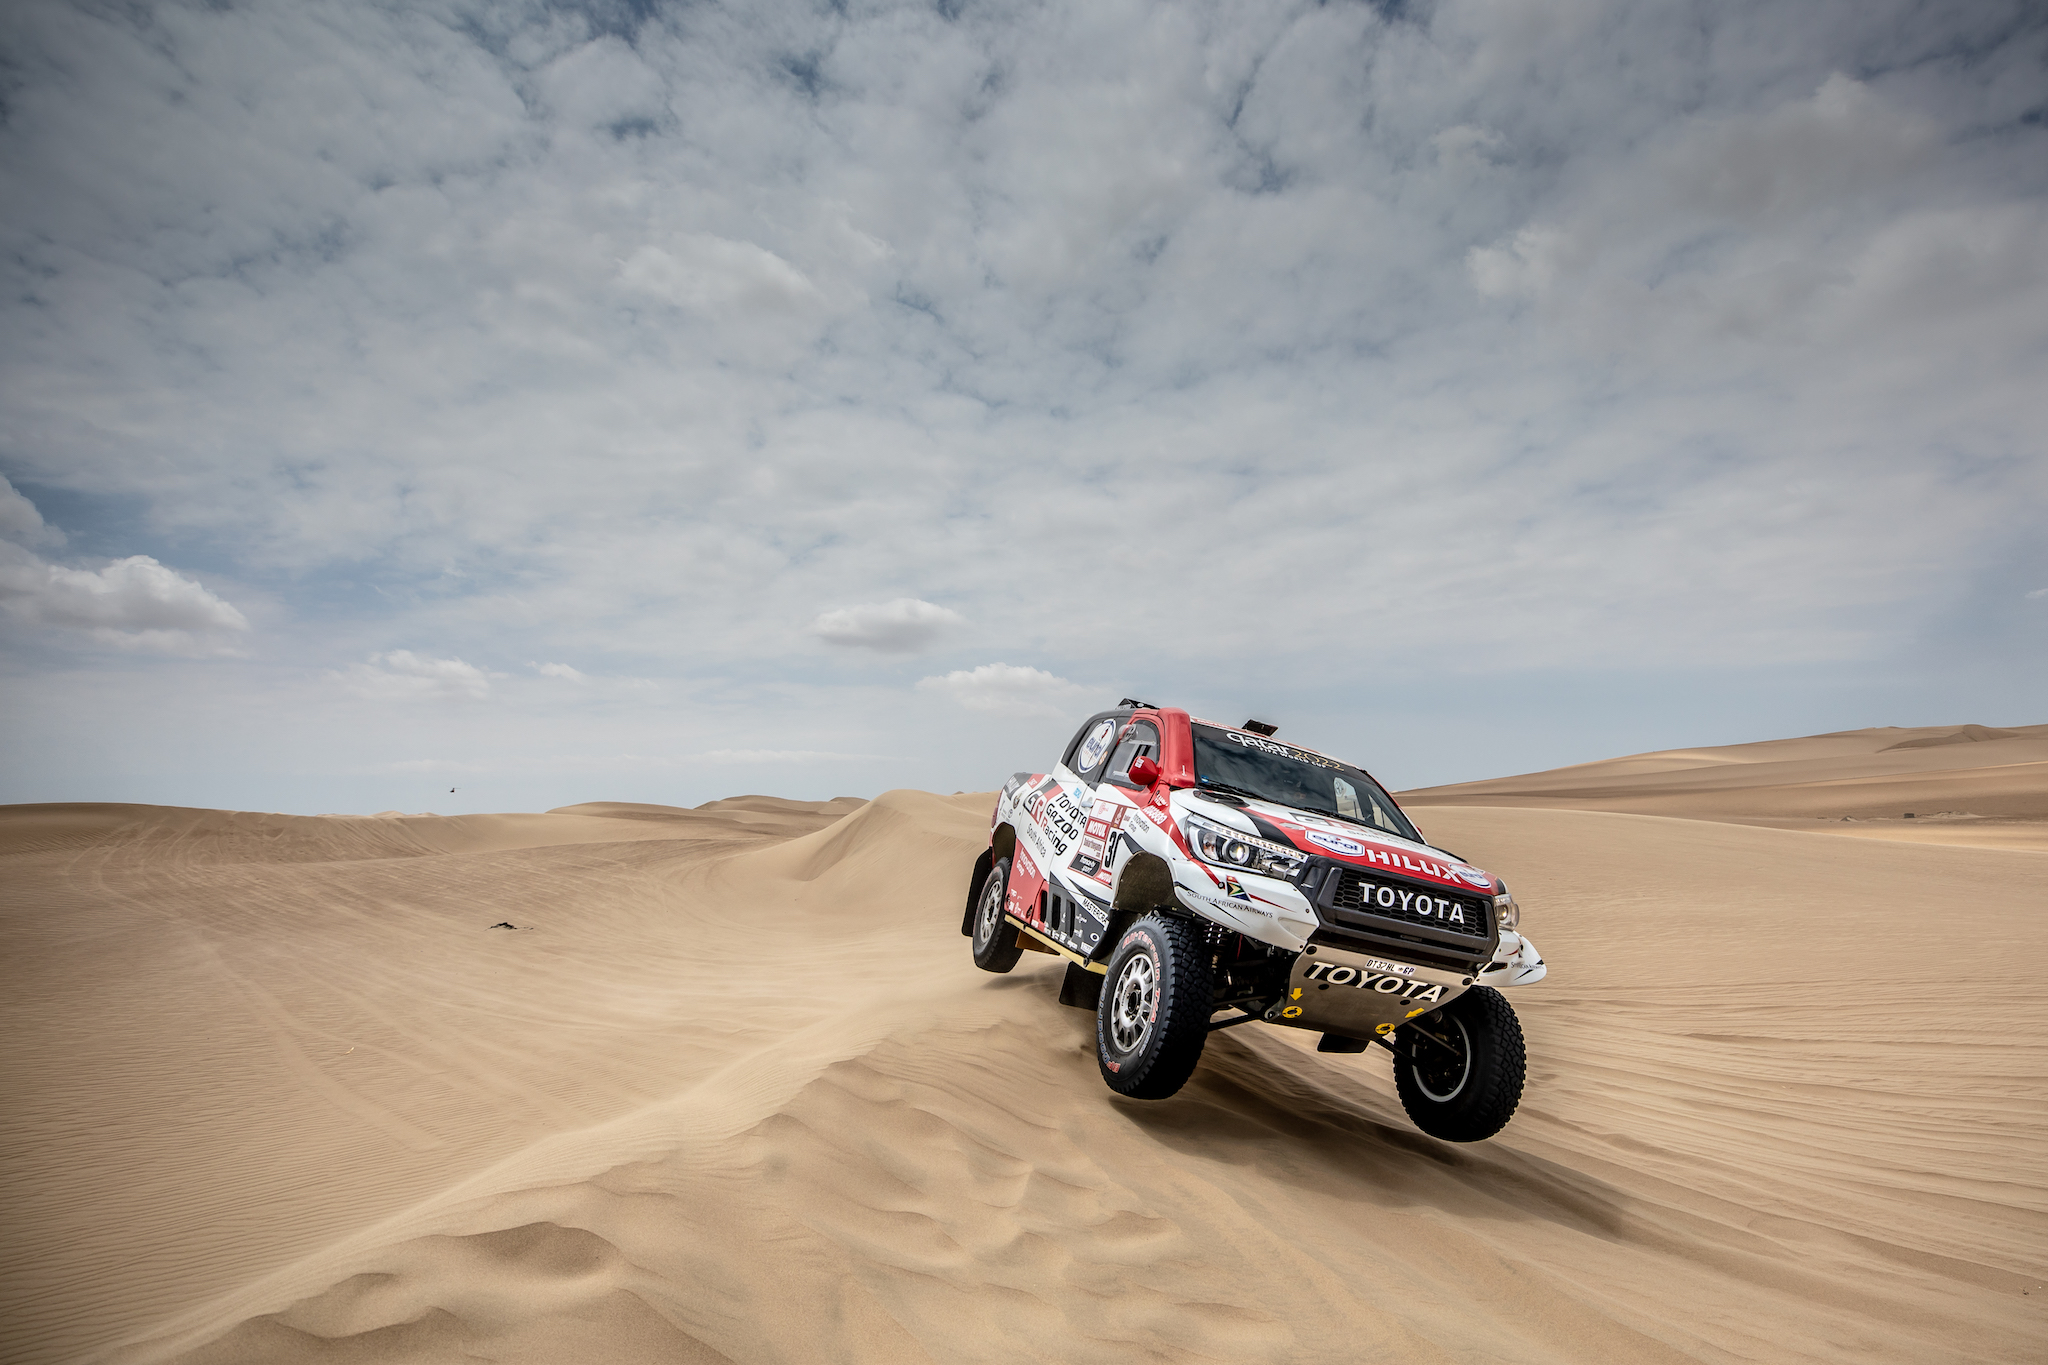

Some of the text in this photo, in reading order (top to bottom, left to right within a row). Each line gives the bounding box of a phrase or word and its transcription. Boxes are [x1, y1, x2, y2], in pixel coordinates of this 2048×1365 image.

[1226, 732, 1345, 772] qatar 2022
[1260, 747, 1278, 756] FIFA
[1280, 752, 1309, 764] WORLD
[1046, 803, 1078, 840] GAZOO
[1056, 793, 1087, 828] TOYOTA
[1041, 816, 1068, 856] Racing
[1086, 820, 1107, 838] MOTUL
[1313, 833, 1358, 852] eurol
[1366, 849, 1462, 884] HILUX
[1211, 898, 1243, 911] AFRICAN
[1243, 905, 1274, 919] AIRWAYS
[1358, 881, 1466, 924] TOYOTA
[1308, 961, 1444, 1003] TOYOTA
